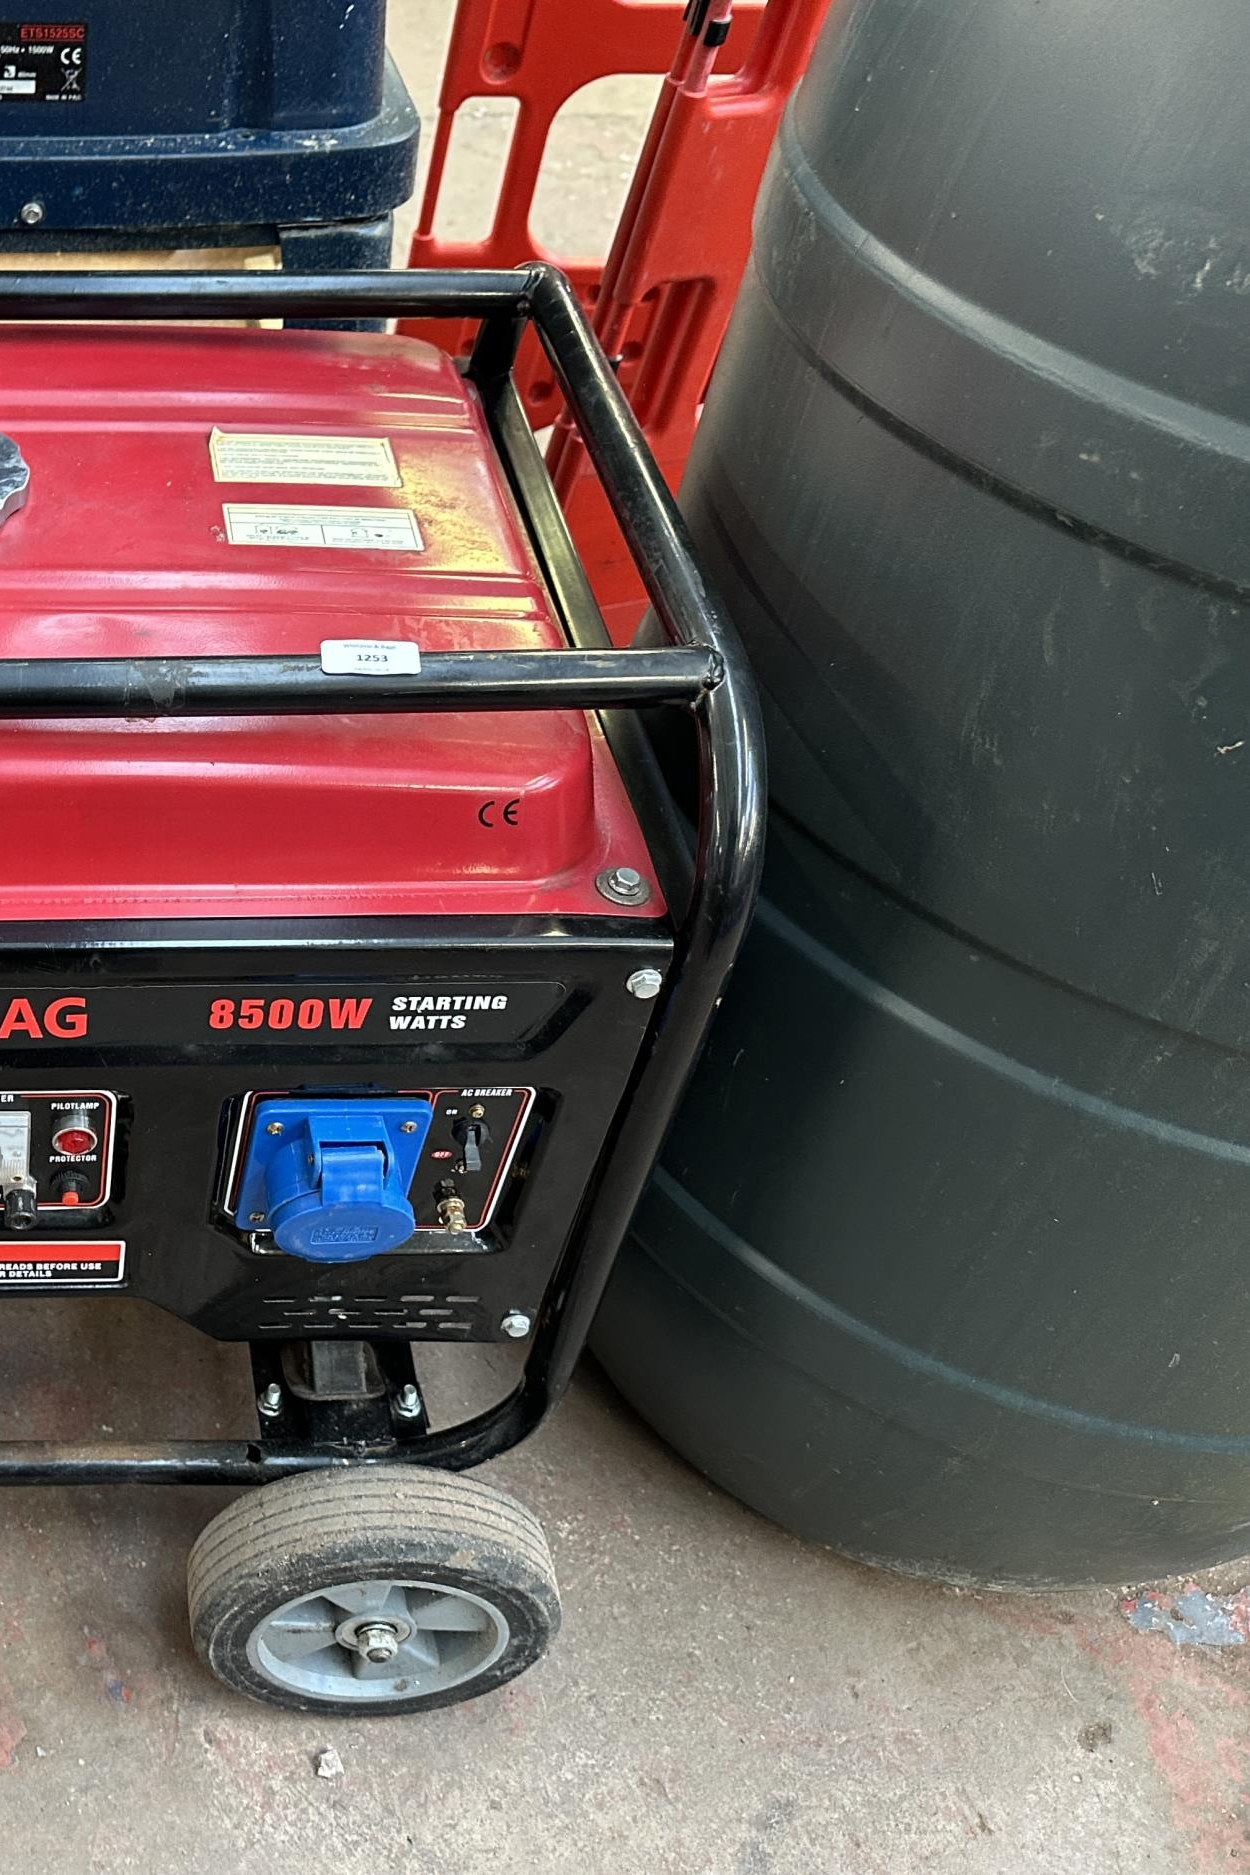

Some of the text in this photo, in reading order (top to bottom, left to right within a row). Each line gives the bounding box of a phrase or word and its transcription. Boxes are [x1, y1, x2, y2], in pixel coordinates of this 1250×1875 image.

[20, 26, 85, 39] ETS1525SC
[356, 654, 388, 662] 1253
[391, 995, 508, 1012] STARTING
[209, 998, 372, 1030] 8500W
[389, 1015, 467, 1030] WATTS
[460, 1088, 513, 1097] AC BREAKER
[50, 1102, 100, 1110] PILOTLAMP
[49, 1154, 97, 1163] PROTECTOR
[9, 1270, 52, 1278] DETAILS
